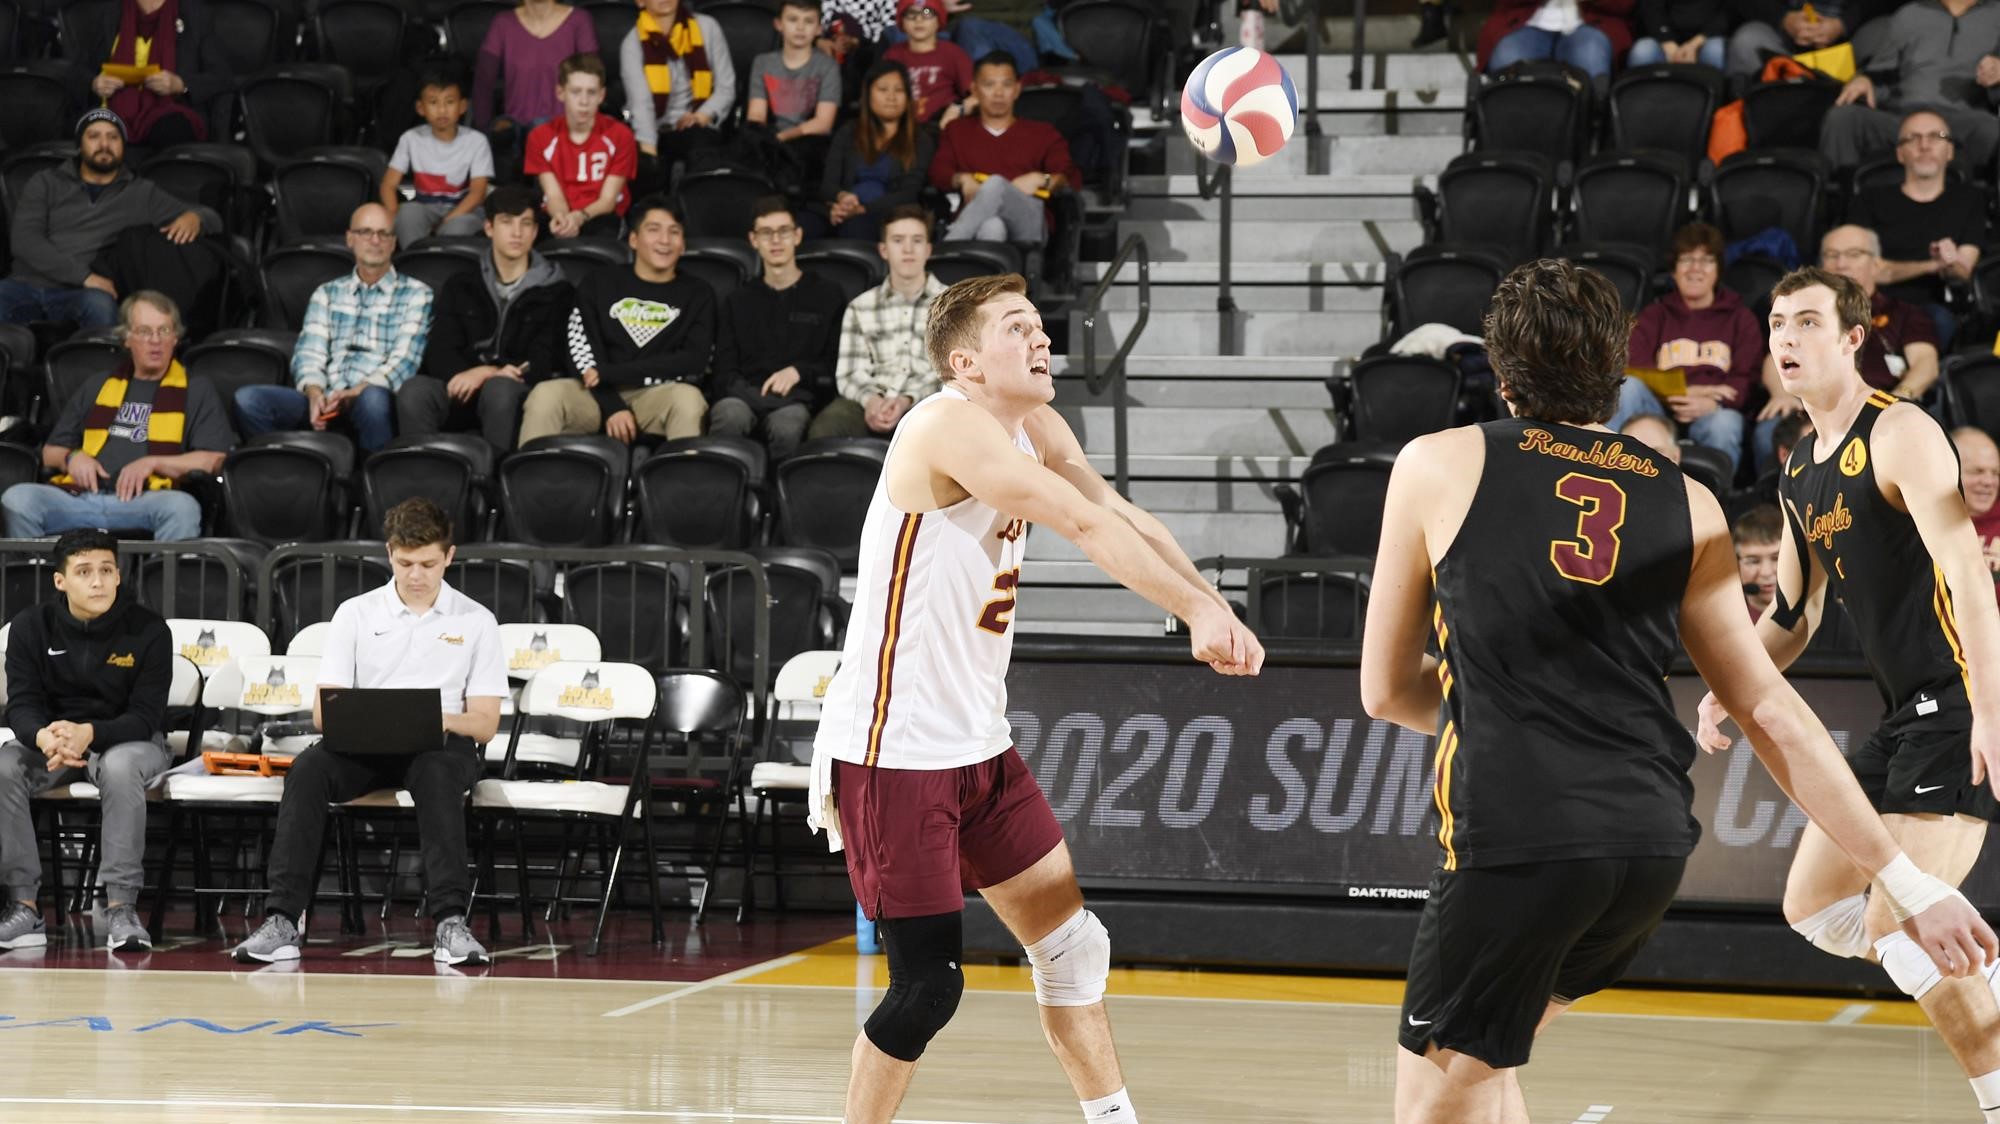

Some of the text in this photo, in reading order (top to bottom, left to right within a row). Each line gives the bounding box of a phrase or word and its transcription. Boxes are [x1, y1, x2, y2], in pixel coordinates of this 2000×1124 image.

[576, 151, 608, 182] 12
[1519, 428, 1659, 477] Ramblers
[1845, 442, 1858, 471] 4
[1550, 471, 1626, 586] 3
[0, 1014, 400, 1038] ANK
